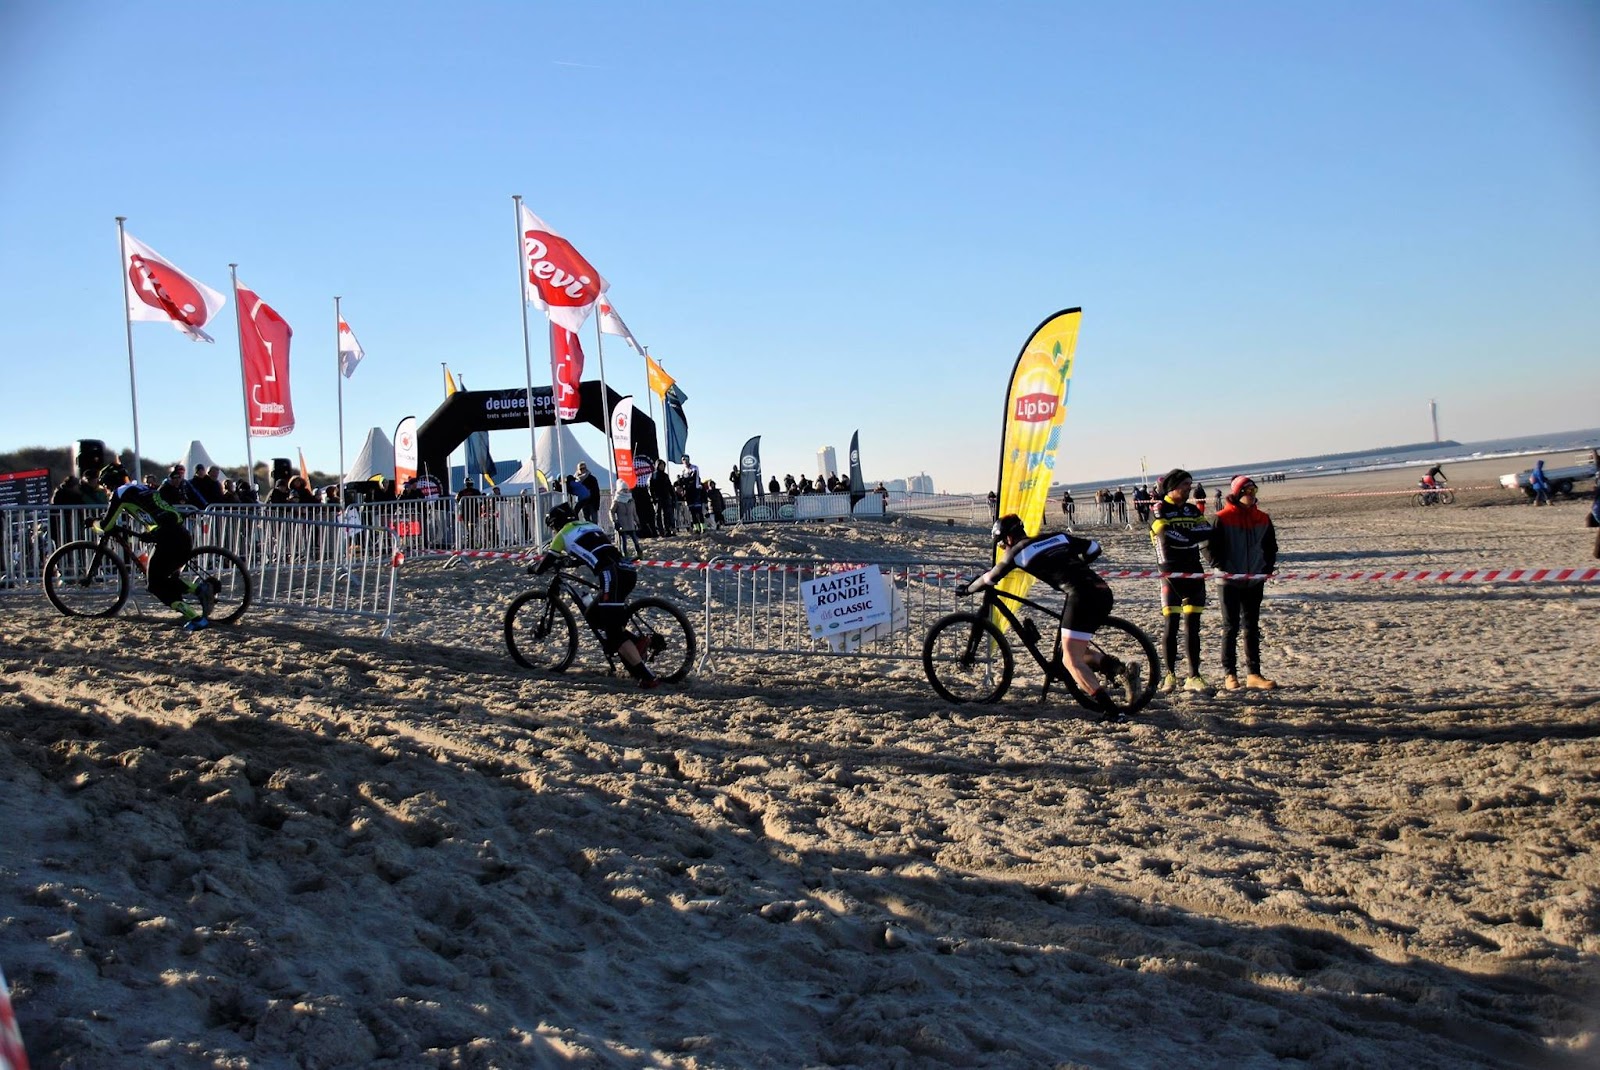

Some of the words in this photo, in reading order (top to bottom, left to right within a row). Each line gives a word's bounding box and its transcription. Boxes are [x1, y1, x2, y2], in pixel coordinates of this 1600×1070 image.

[812, 572, 866, 595] LAATSTE
[817, 584, 870, 606] RONDE!
[833, 600, 873, 617] CLASSIC
